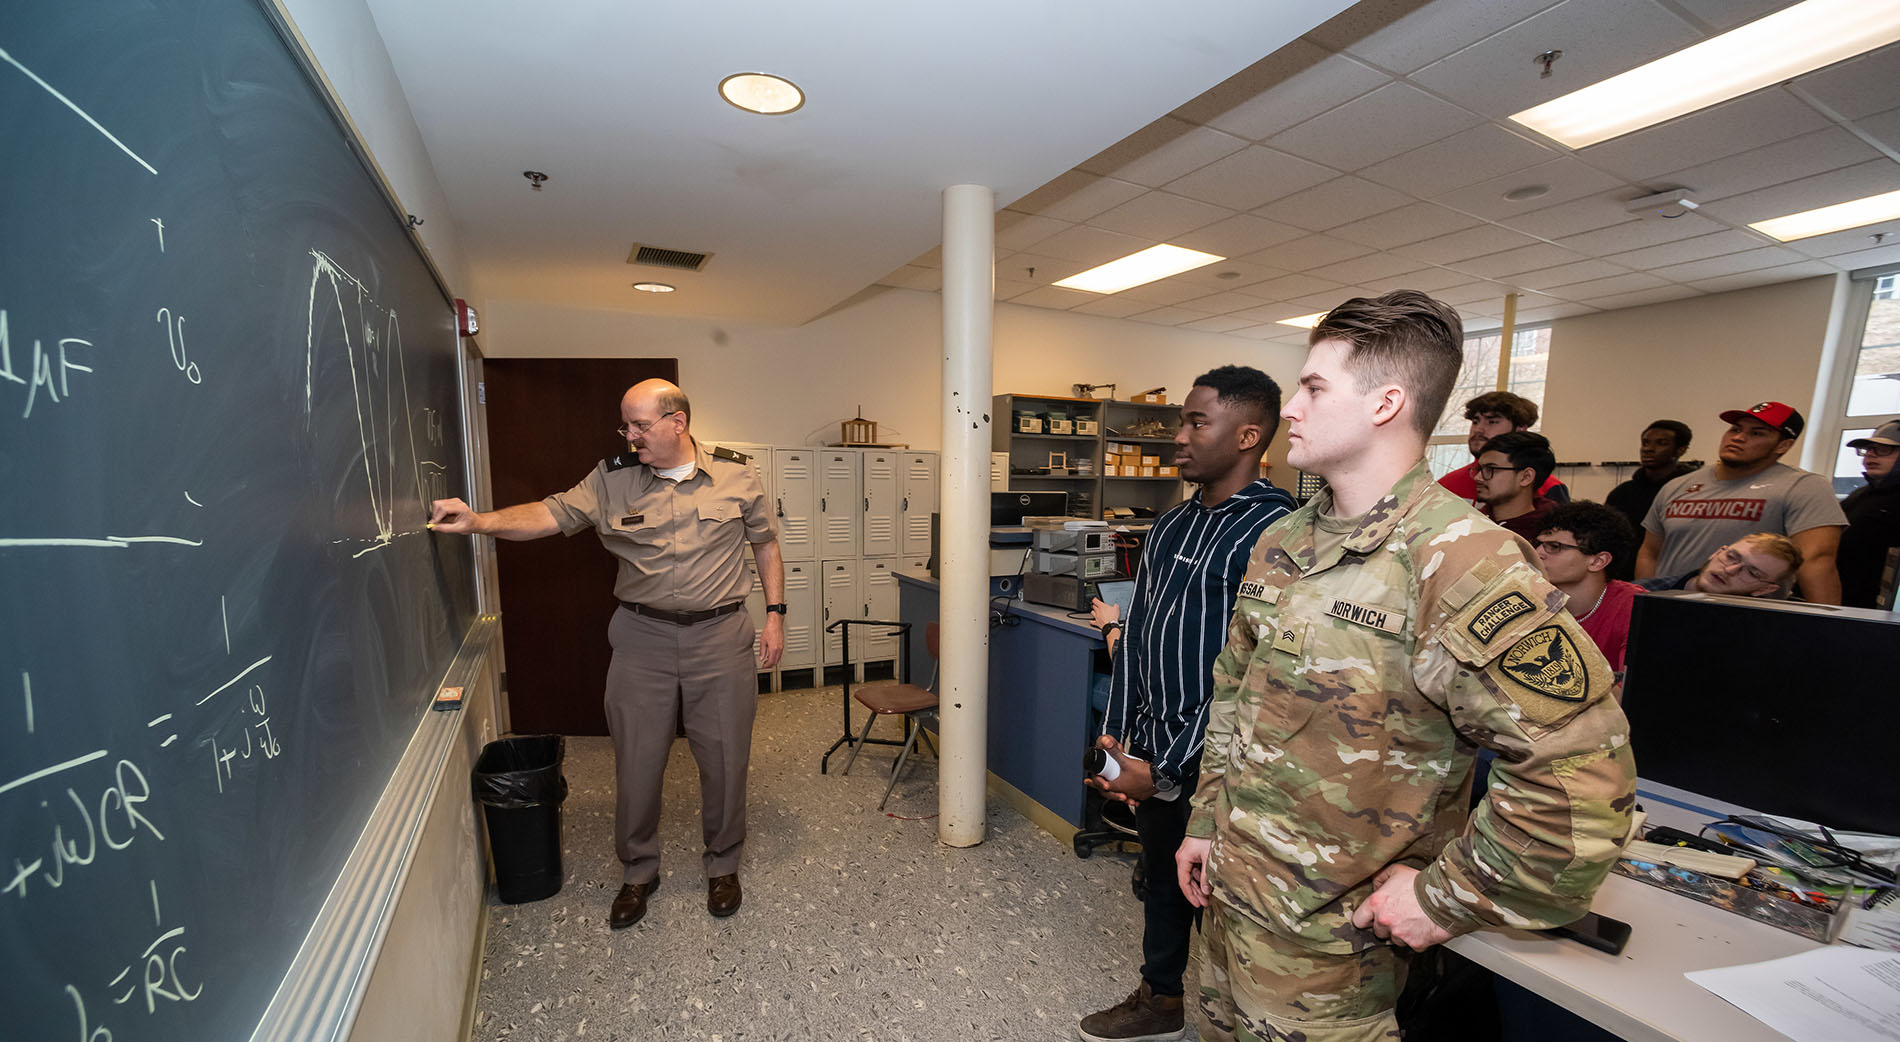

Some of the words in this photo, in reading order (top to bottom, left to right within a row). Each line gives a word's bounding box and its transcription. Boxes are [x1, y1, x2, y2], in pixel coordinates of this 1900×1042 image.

[1668, 501, 1761, 518] NORWICH
[1331, 600, 1387, 628] NORWICH
[1478, 599, 1512, 626] RANGER
[1480, 601, 1528, 637] CHALLENGE
[1508, 631, 1552, 665] NORWICH
[1544, 661, 1563, 678] 1819
